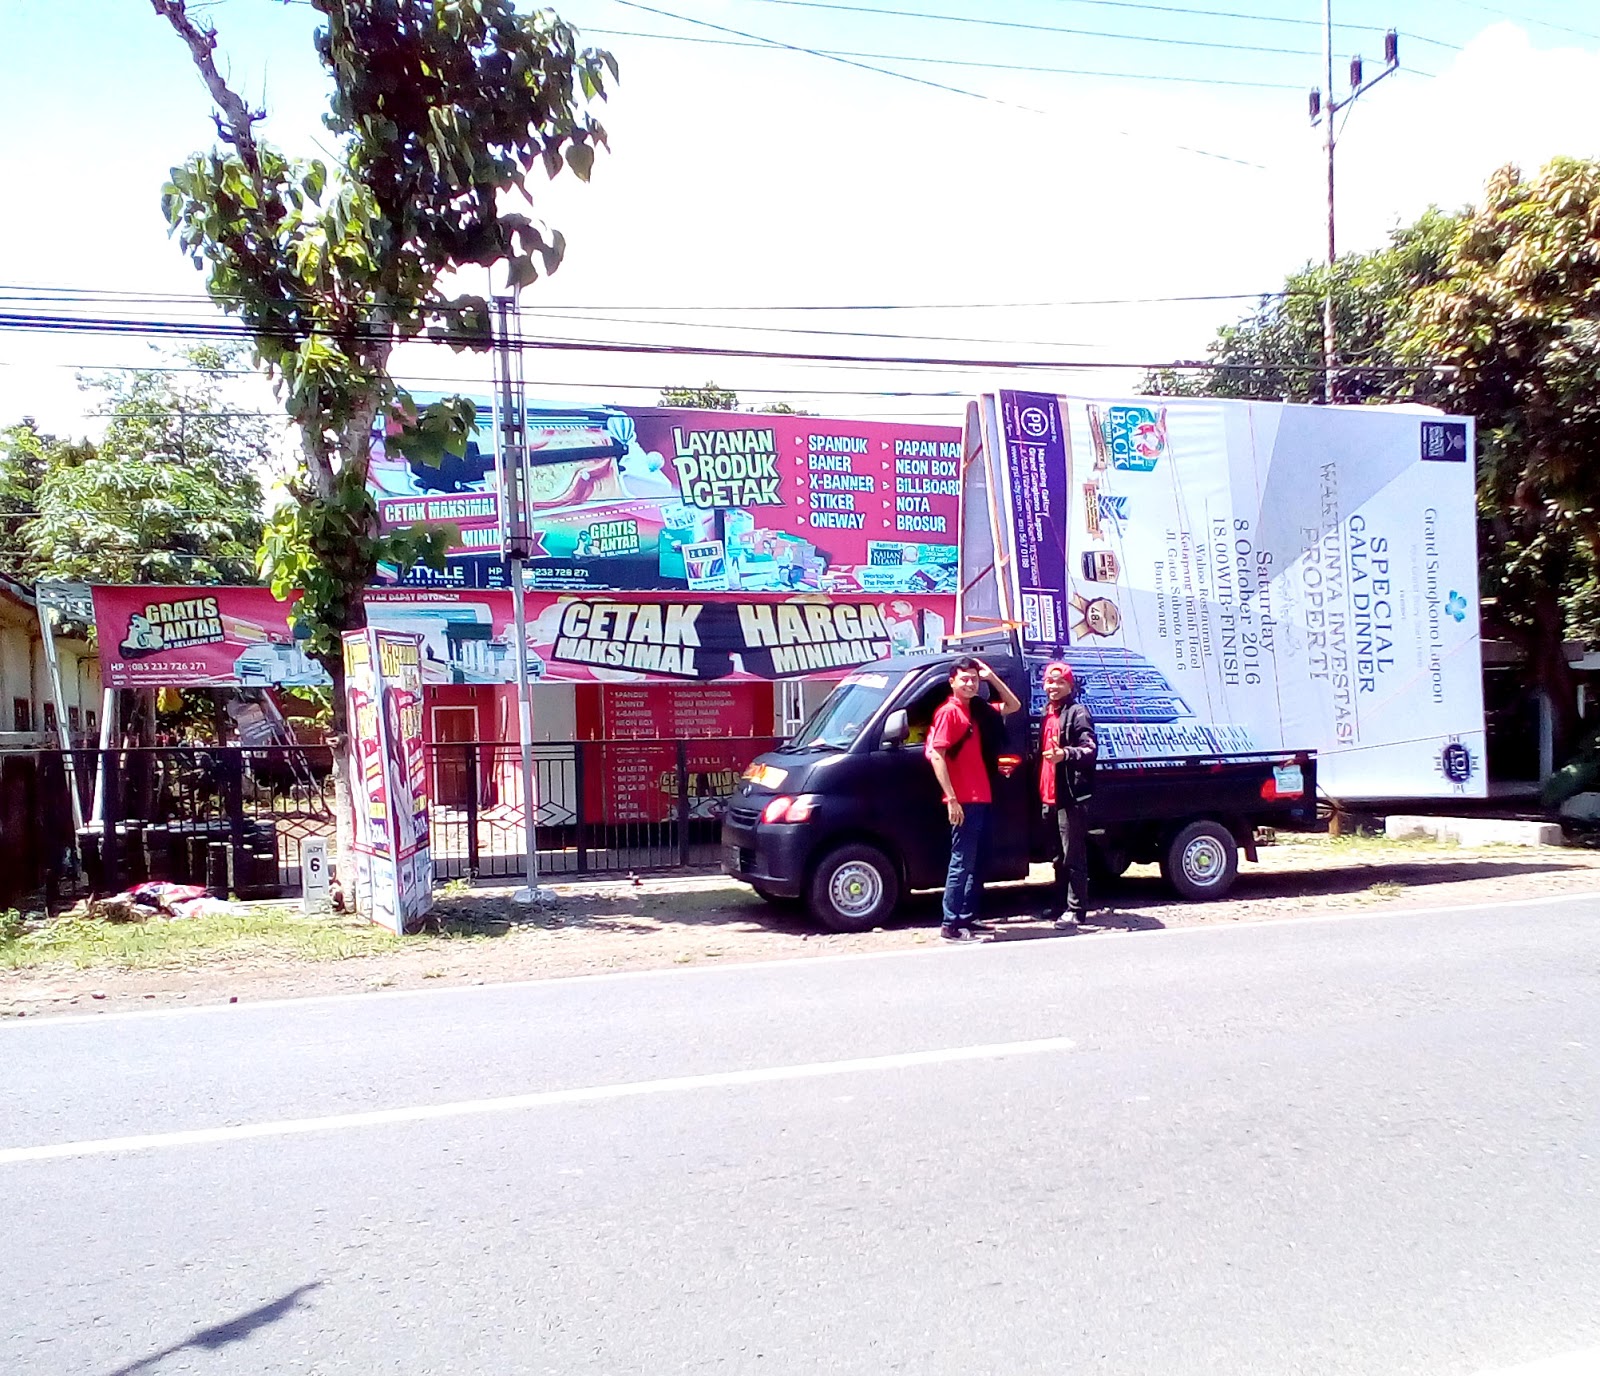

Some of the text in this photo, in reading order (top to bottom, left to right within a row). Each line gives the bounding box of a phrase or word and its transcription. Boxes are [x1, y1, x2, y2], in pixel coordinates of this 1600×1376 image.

[674, 428, 773, 455] LAYANAN
[808, 435, 867, 453] SPANDUK
[895, 440, 936, 456] PAPAN
[1111, 411, 1129, 468] BACK
[673, 455, 778, 502] PRODUK
[809, 454, 851, 472] BANER
[896, 459, 956, 476] NEON BOX
[1038, 448, 1047, 487] Marketing
[694, 479, 782, 507] CETAK
[809, 473, 874, 492] X-BANNER
[896, 477, 960, 496] BILLBOARD
[1029, 447, 1043, 541] Grand Sungkono Lagoon
[385, 498, 496, 522] CETAK MAKSIMAL
[810, 492, 854, 510] STIKER
[896, 497, 930, 512] NOTA
[590, 521, 637, 539] GRATIS
[810, 512, 865, 529] ONEWAY
[897, 515, 946, 533] BROSUR
[601, 535, 638, 551] ANTAR
[488, 567, 502, 575] HP
[1167, 549, 1180, 582] Gatot
[146, 598, 217, 624] GRATIS
[1154, 561, 1167, 638] Banyuwangi
[1171, 587, 1183, 635] Subroto
[1185, 595, 1197, 631] Indah
[1233, 519, 1260, 685] 8 October 2016
[1256, 551, 1277, 653] Saturday
[1300, 528, 1329, 680] PROPERTI
[1350, 515, 1374, 694] GALA DINNER
[1370, 537, 1394, 673] SPECIAL
[1424, 508, 1443, 704] Grand Sungkono Lagoon
[164, 618, 221, 641] ANTAR
[562, 601, 703, 647] CETAK
[737, 604, 889, 647] HARGA
[1198, 588, 1212, 657] Restaurant
[554, 638, 699, 676] MAKSIMAL
[770, 641, 879, 675] MINIMAL
[1175, 640, 1185, 658] km
[1188, 636, 1200, 669] Hotel
[1328, 612, 1353, 746] INVESTASI
[311, 858, 320, 872] 6
